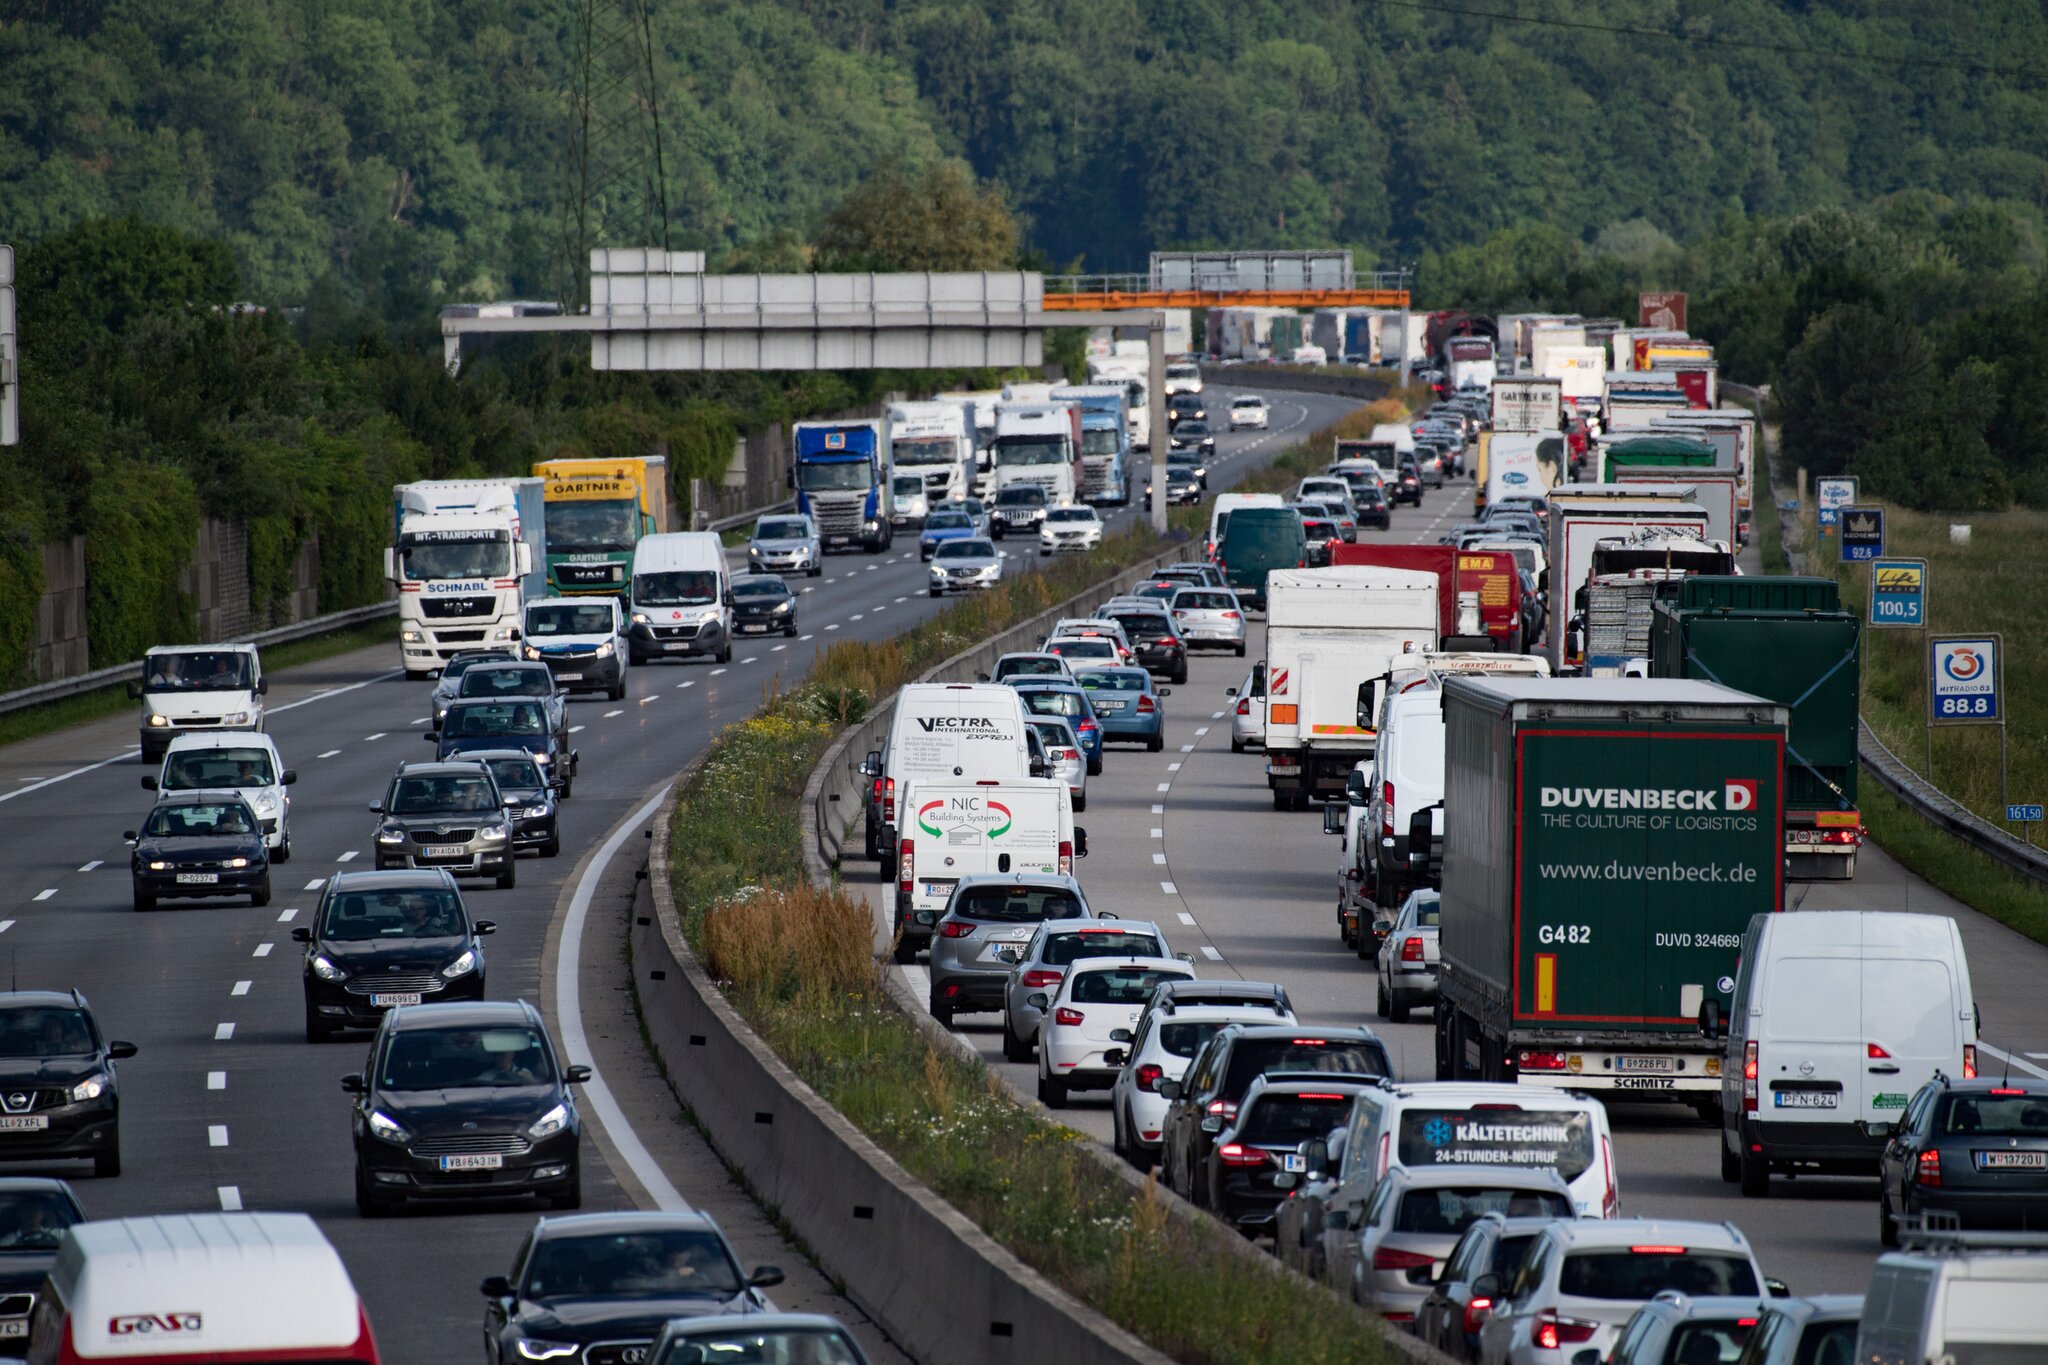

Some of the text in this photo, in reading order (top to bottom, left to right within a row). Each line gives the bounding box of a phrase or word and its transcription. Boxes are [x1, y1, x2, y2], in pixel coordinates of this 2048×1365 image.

[554, 483, 620, 493] GARTNER
[1821, 511, 1836, 522] 96,
[415, 530, 495, 541] INT.-TRANSPORTE
[569, 554, 608, 562] GARTNER
[1879, 570, 1919, 585] Life
[427, 583, 488, 592] SCHNABL
[1877, 601, 1917, 618] 100,5
[1943, 698, 1987, 713] 88.8
[917, 717, 994, 732] VECTRA
[952, 797, 979, 810] NIC
[1541, 787, 1717, 811] DUVENBECK
[929, 812, 1001, 823] Building Systems
[2009, 807, 2040, 820] 161,50
[1541, 813, 1757, 831] THE CULTURE OF LOGISTICS
[1539, 860, 1757, 882] www.duvenbeck.de
[1538, 925, 1591, 944] G482
[1655, 933, 1739, 948] DUVD 324669
[1614, 1079, 1675, 1088] SCHMITZ
[1456, 1122, 1569, 1142] KÄLTETECHNIK
[1436, 1150, 1558, 1163] 24-STUNDEN-NOTRUF
